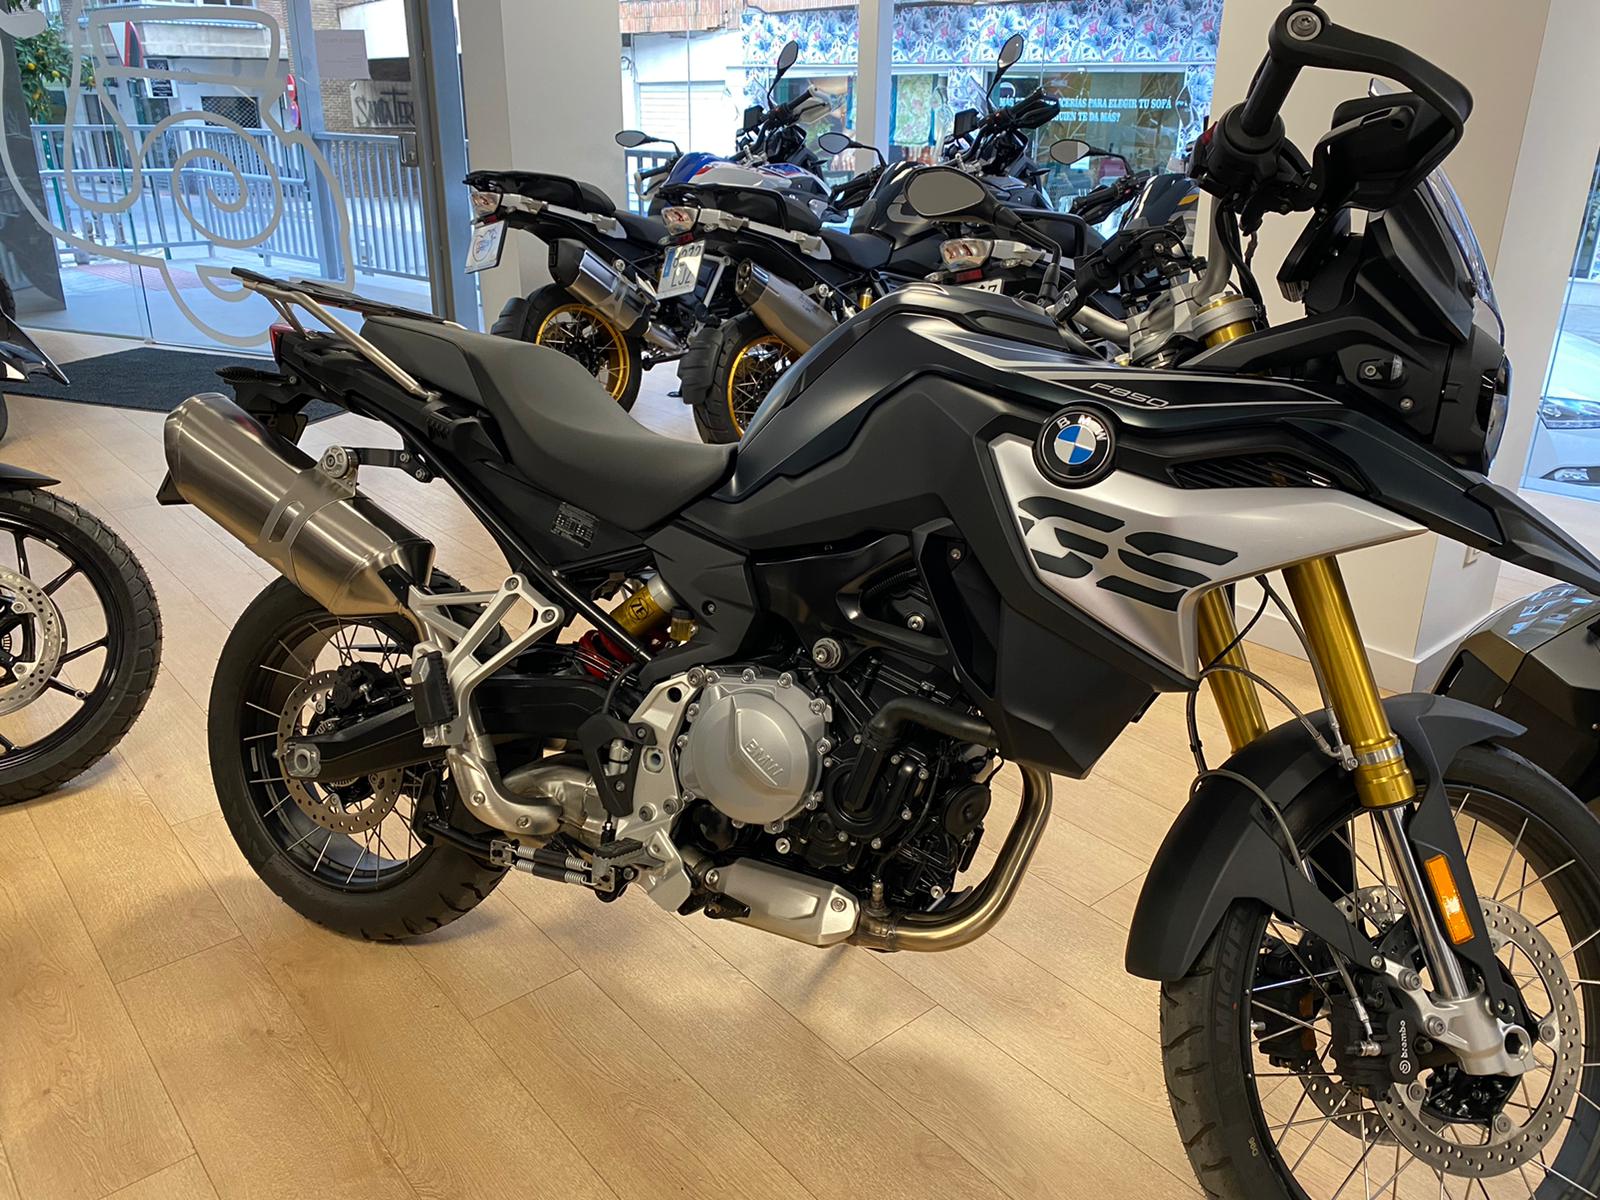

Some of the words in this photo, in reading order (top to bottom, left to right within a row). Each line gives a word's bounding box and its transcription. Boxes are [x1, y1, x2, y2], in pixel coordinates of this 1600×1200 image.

[1088, 98, 1107, 109] PARA
[1108, 98, 1137, 109] ELEGIR
[1139, 98, 1149, 109] TU
[1151, 96, 1172, 109] SOFÁ
[1078, 111, 1088, 122] TE
[1089, 111, 1099, 122] DA
[1100, 110, 1121, 123] MÁS?
[1090, 382, 1169, 408] F850
[1056, 414, 1108, 442] BMW
[744, 737, 784, 776] BMW
[1398, 1019, 1409, 1059] brembo
